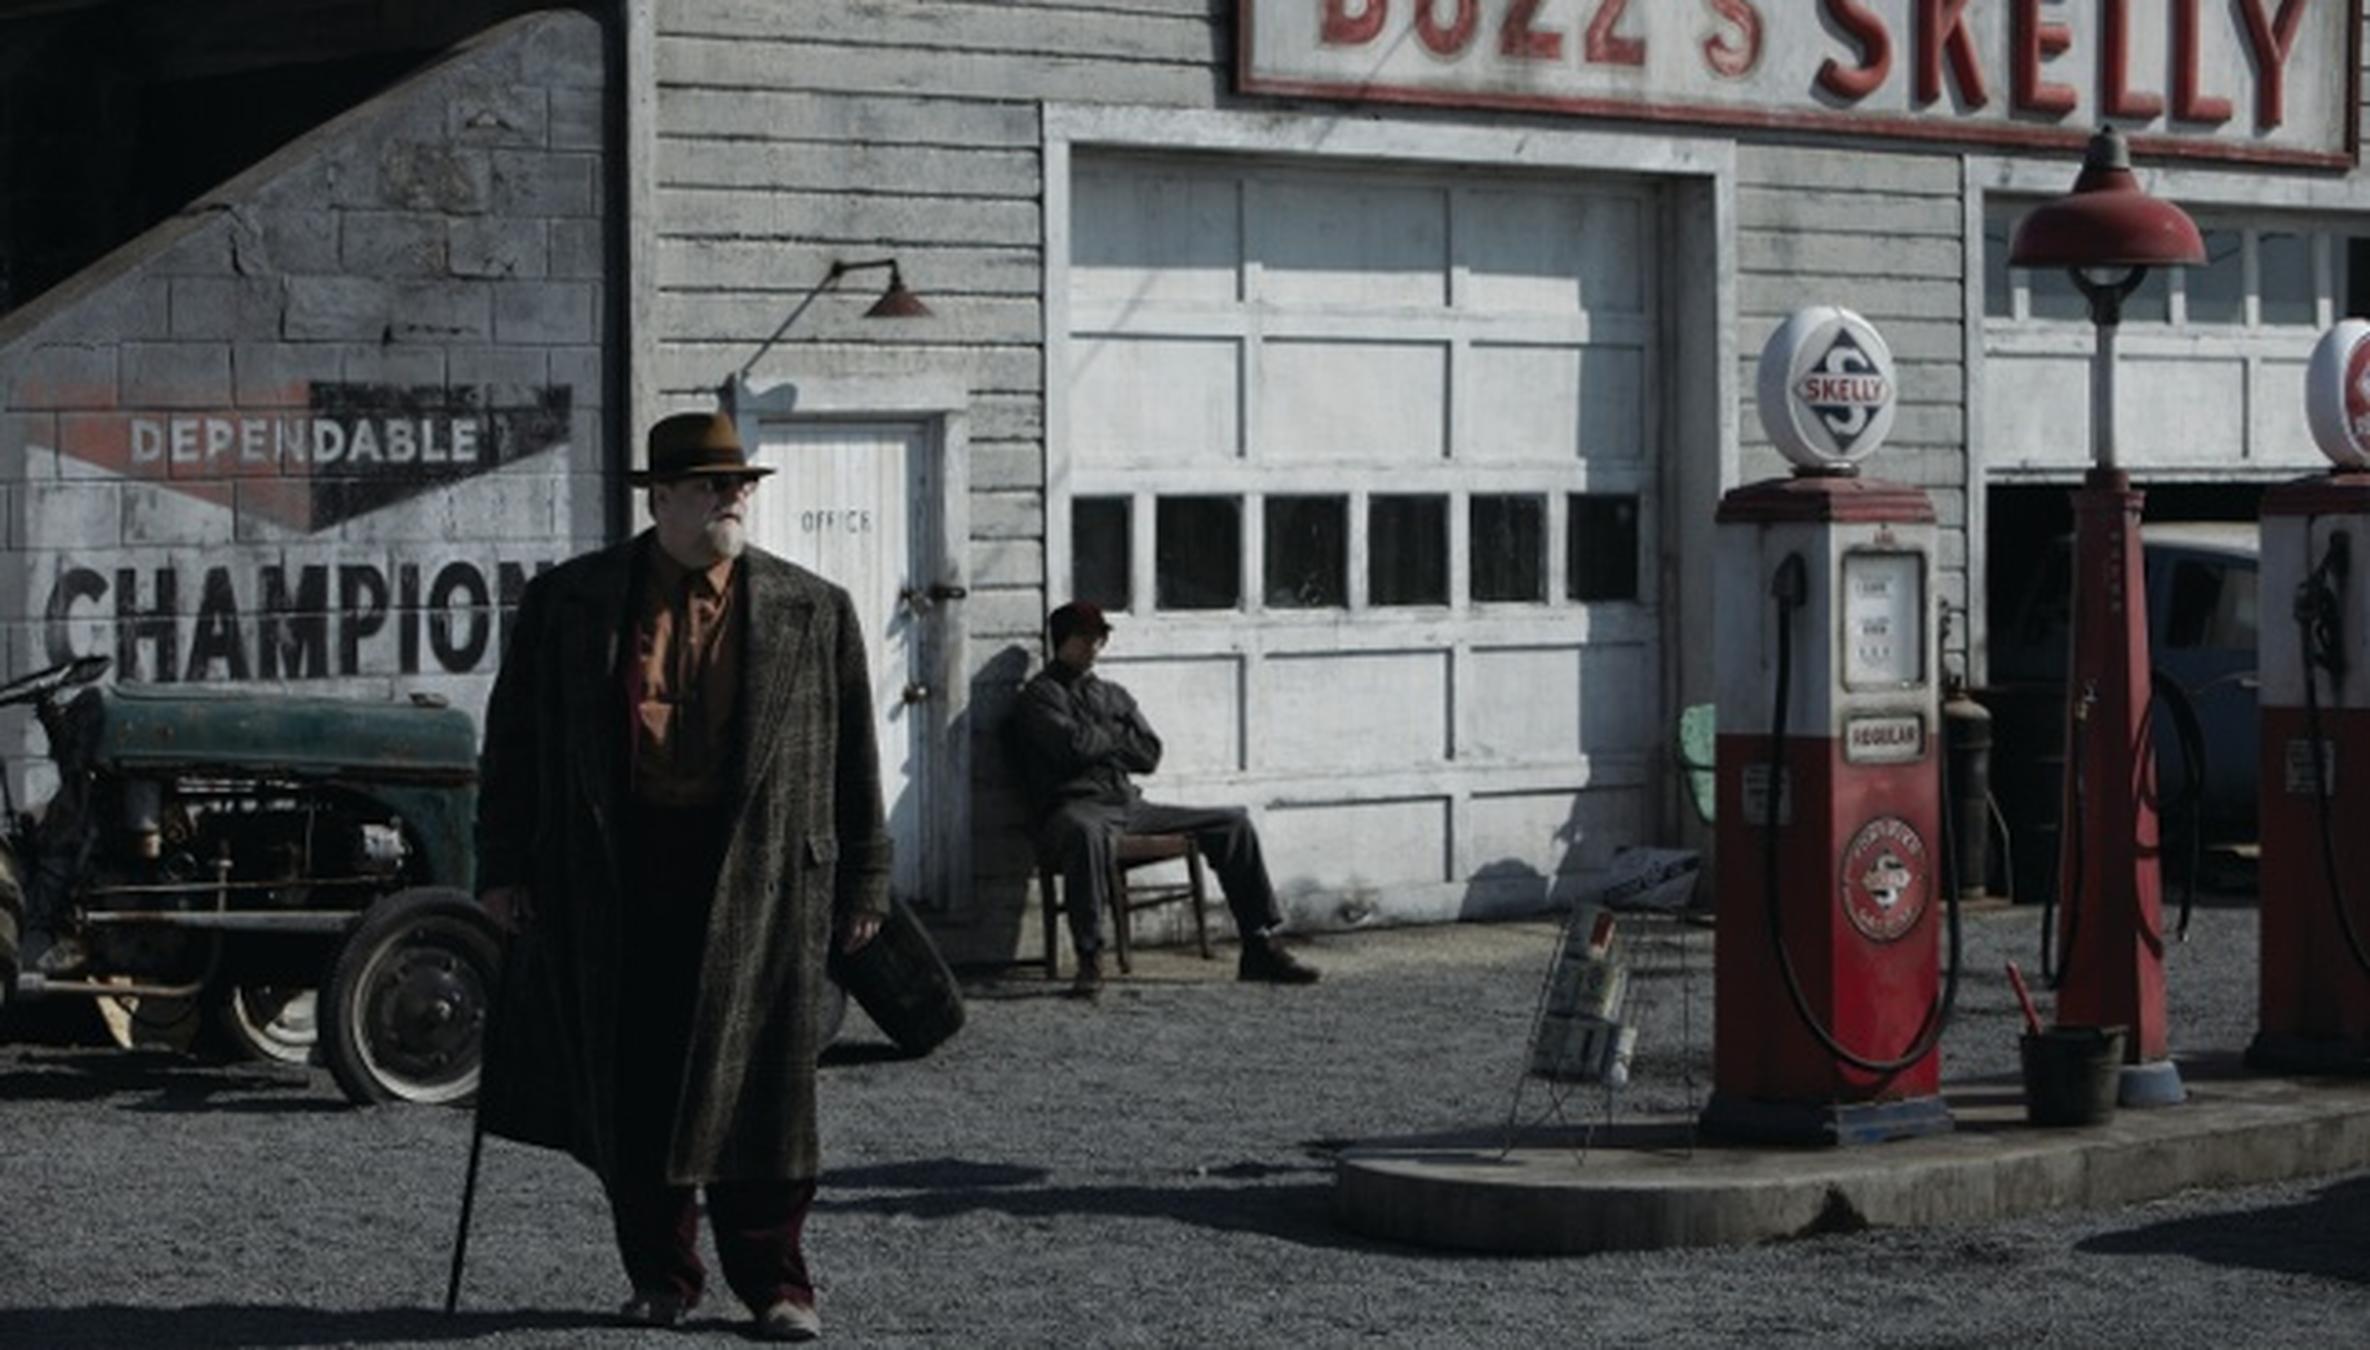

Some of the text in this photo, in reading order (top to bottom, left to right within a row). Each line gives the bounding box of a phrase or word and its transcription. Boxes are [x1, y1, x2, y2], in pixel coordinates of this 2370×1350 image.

[1814, 0, 2306, 131] SKELLY
[1806, 377, 1883, 402] SKELLY
[131, 418, 478, 462] DEPENDABLE
[801, 510, 872, 533] OFFICE
